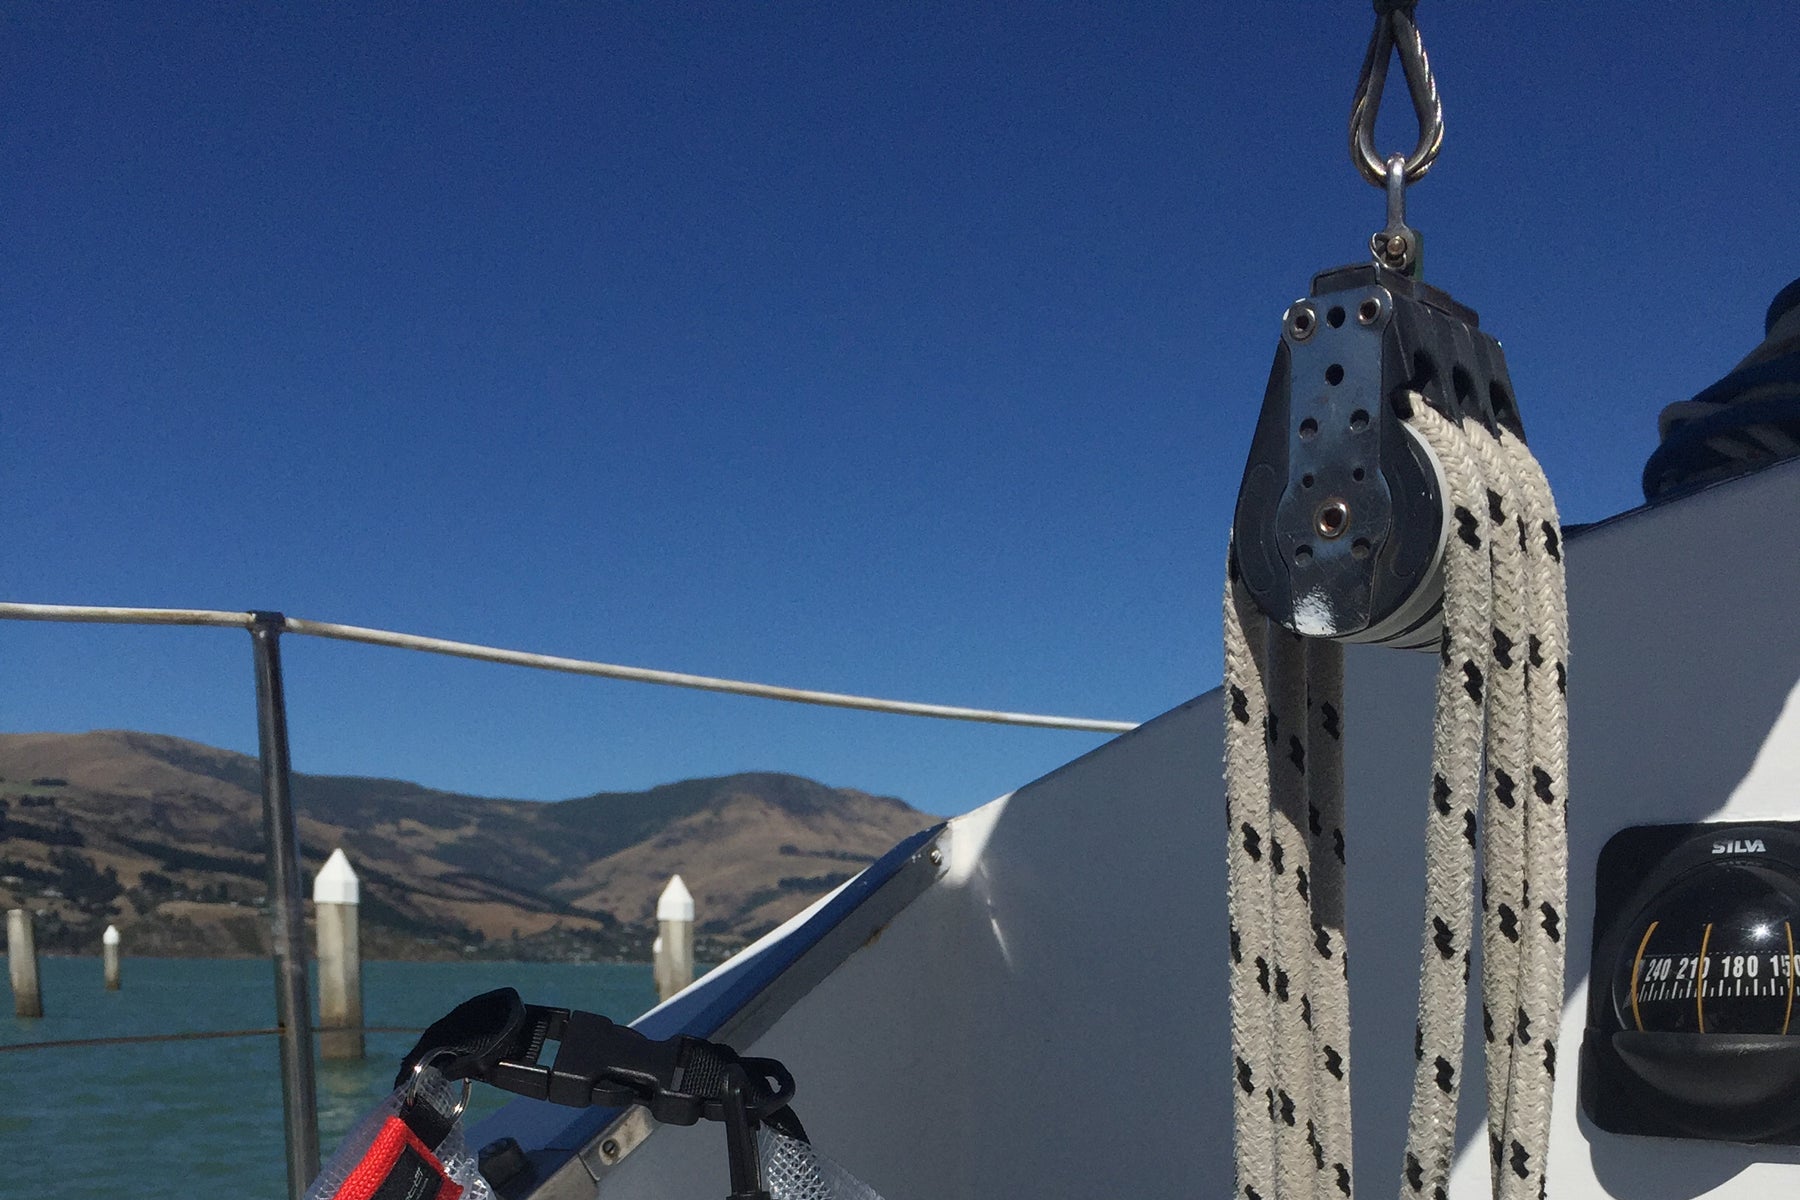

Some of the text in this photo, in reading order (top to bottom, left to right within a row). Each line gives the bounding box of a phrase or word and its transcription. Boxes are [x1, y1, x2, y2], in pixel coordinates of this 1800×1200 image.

[1712, 839, 1766, 854] SILVA
[1645, 958, 1672, 982] 240
[1676, 956, 1711, 980] 210
[1721, 955, 1759, 978] 180
